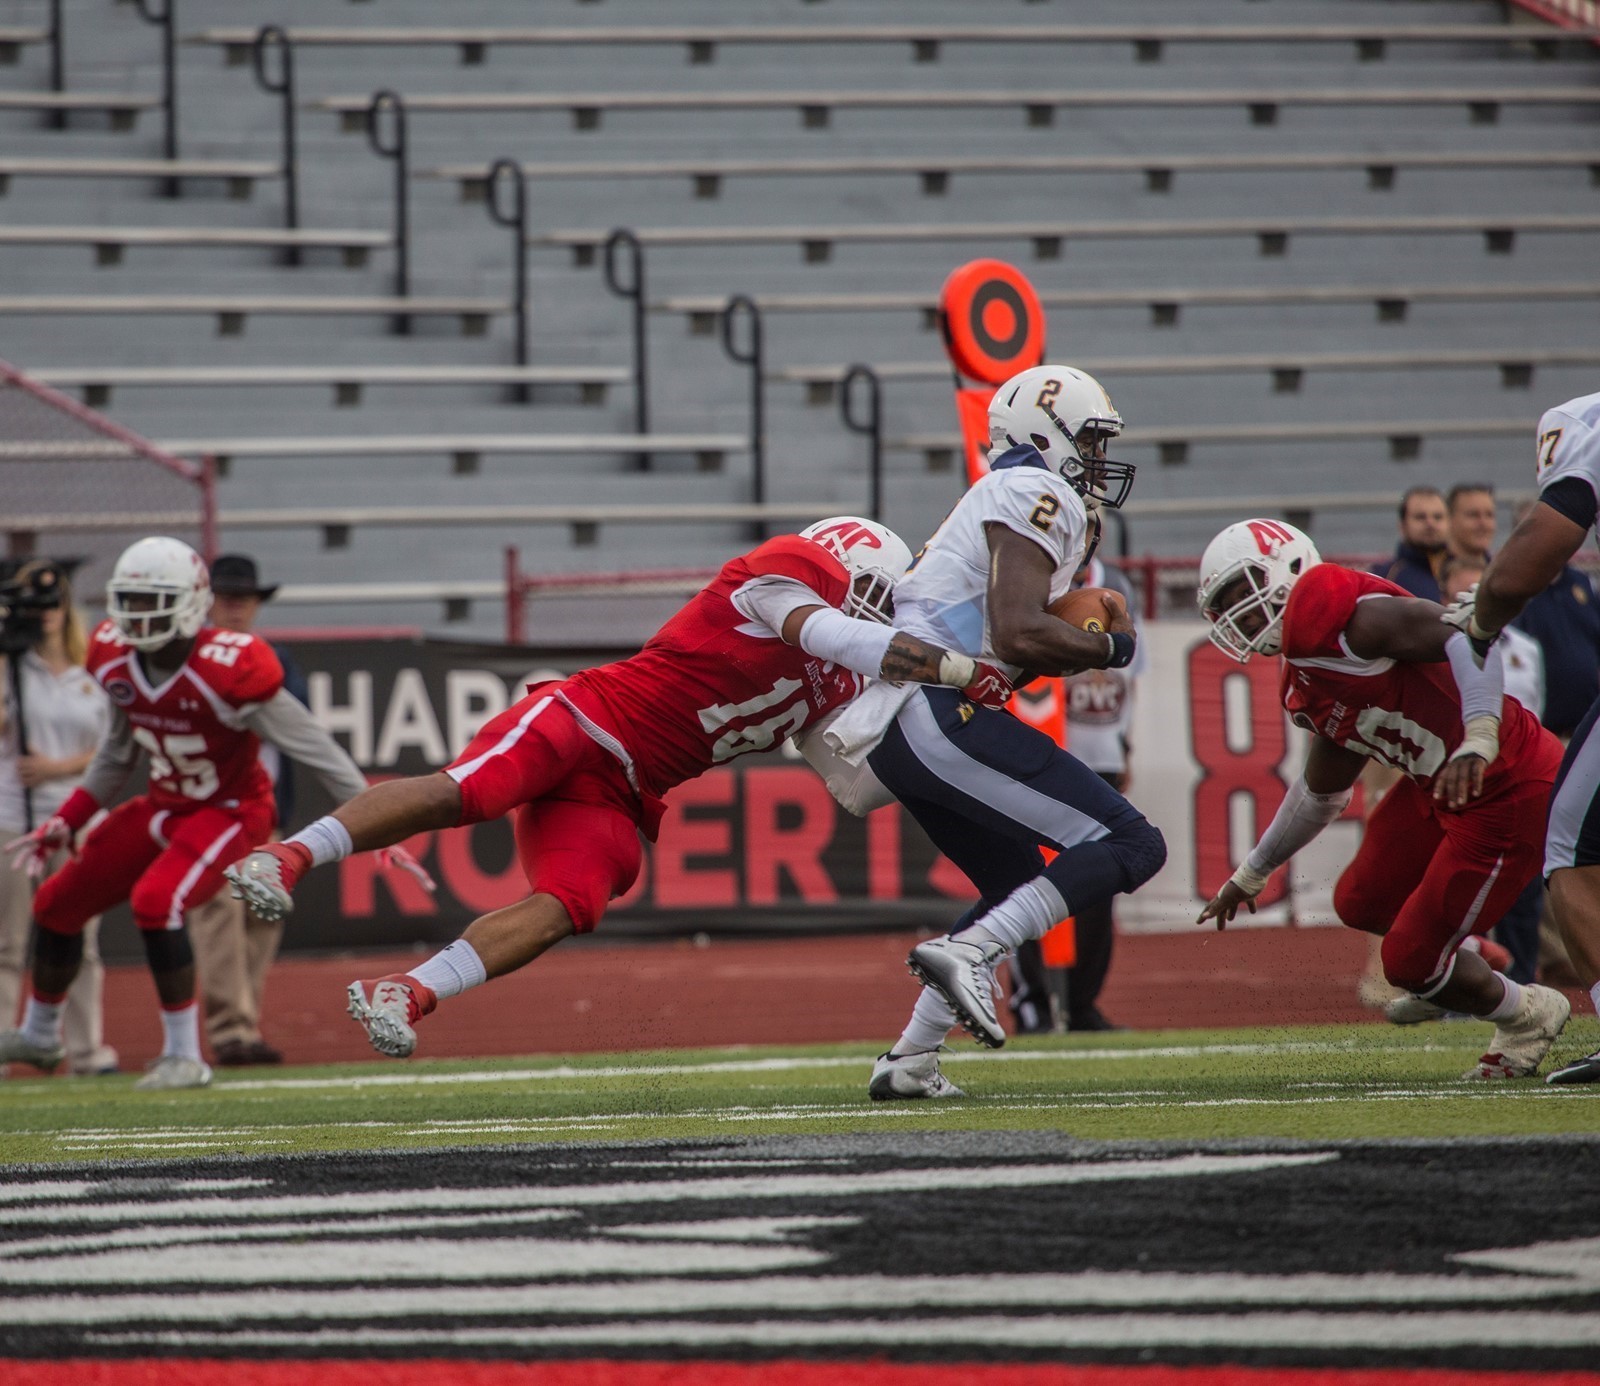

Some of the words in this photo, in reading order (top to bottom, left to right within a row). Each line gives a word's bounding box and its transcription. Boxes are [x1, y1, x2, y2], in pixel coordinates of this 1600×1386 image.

[1035, 379, 1063, 410] 2
[1537, 427, 1564, 474] 7
[1029, 494, 1060, 531] 2
[199, 631, 253, 667] 25
[697, 677, 809, 763] 16
[132, 727, 220, 801] 25
